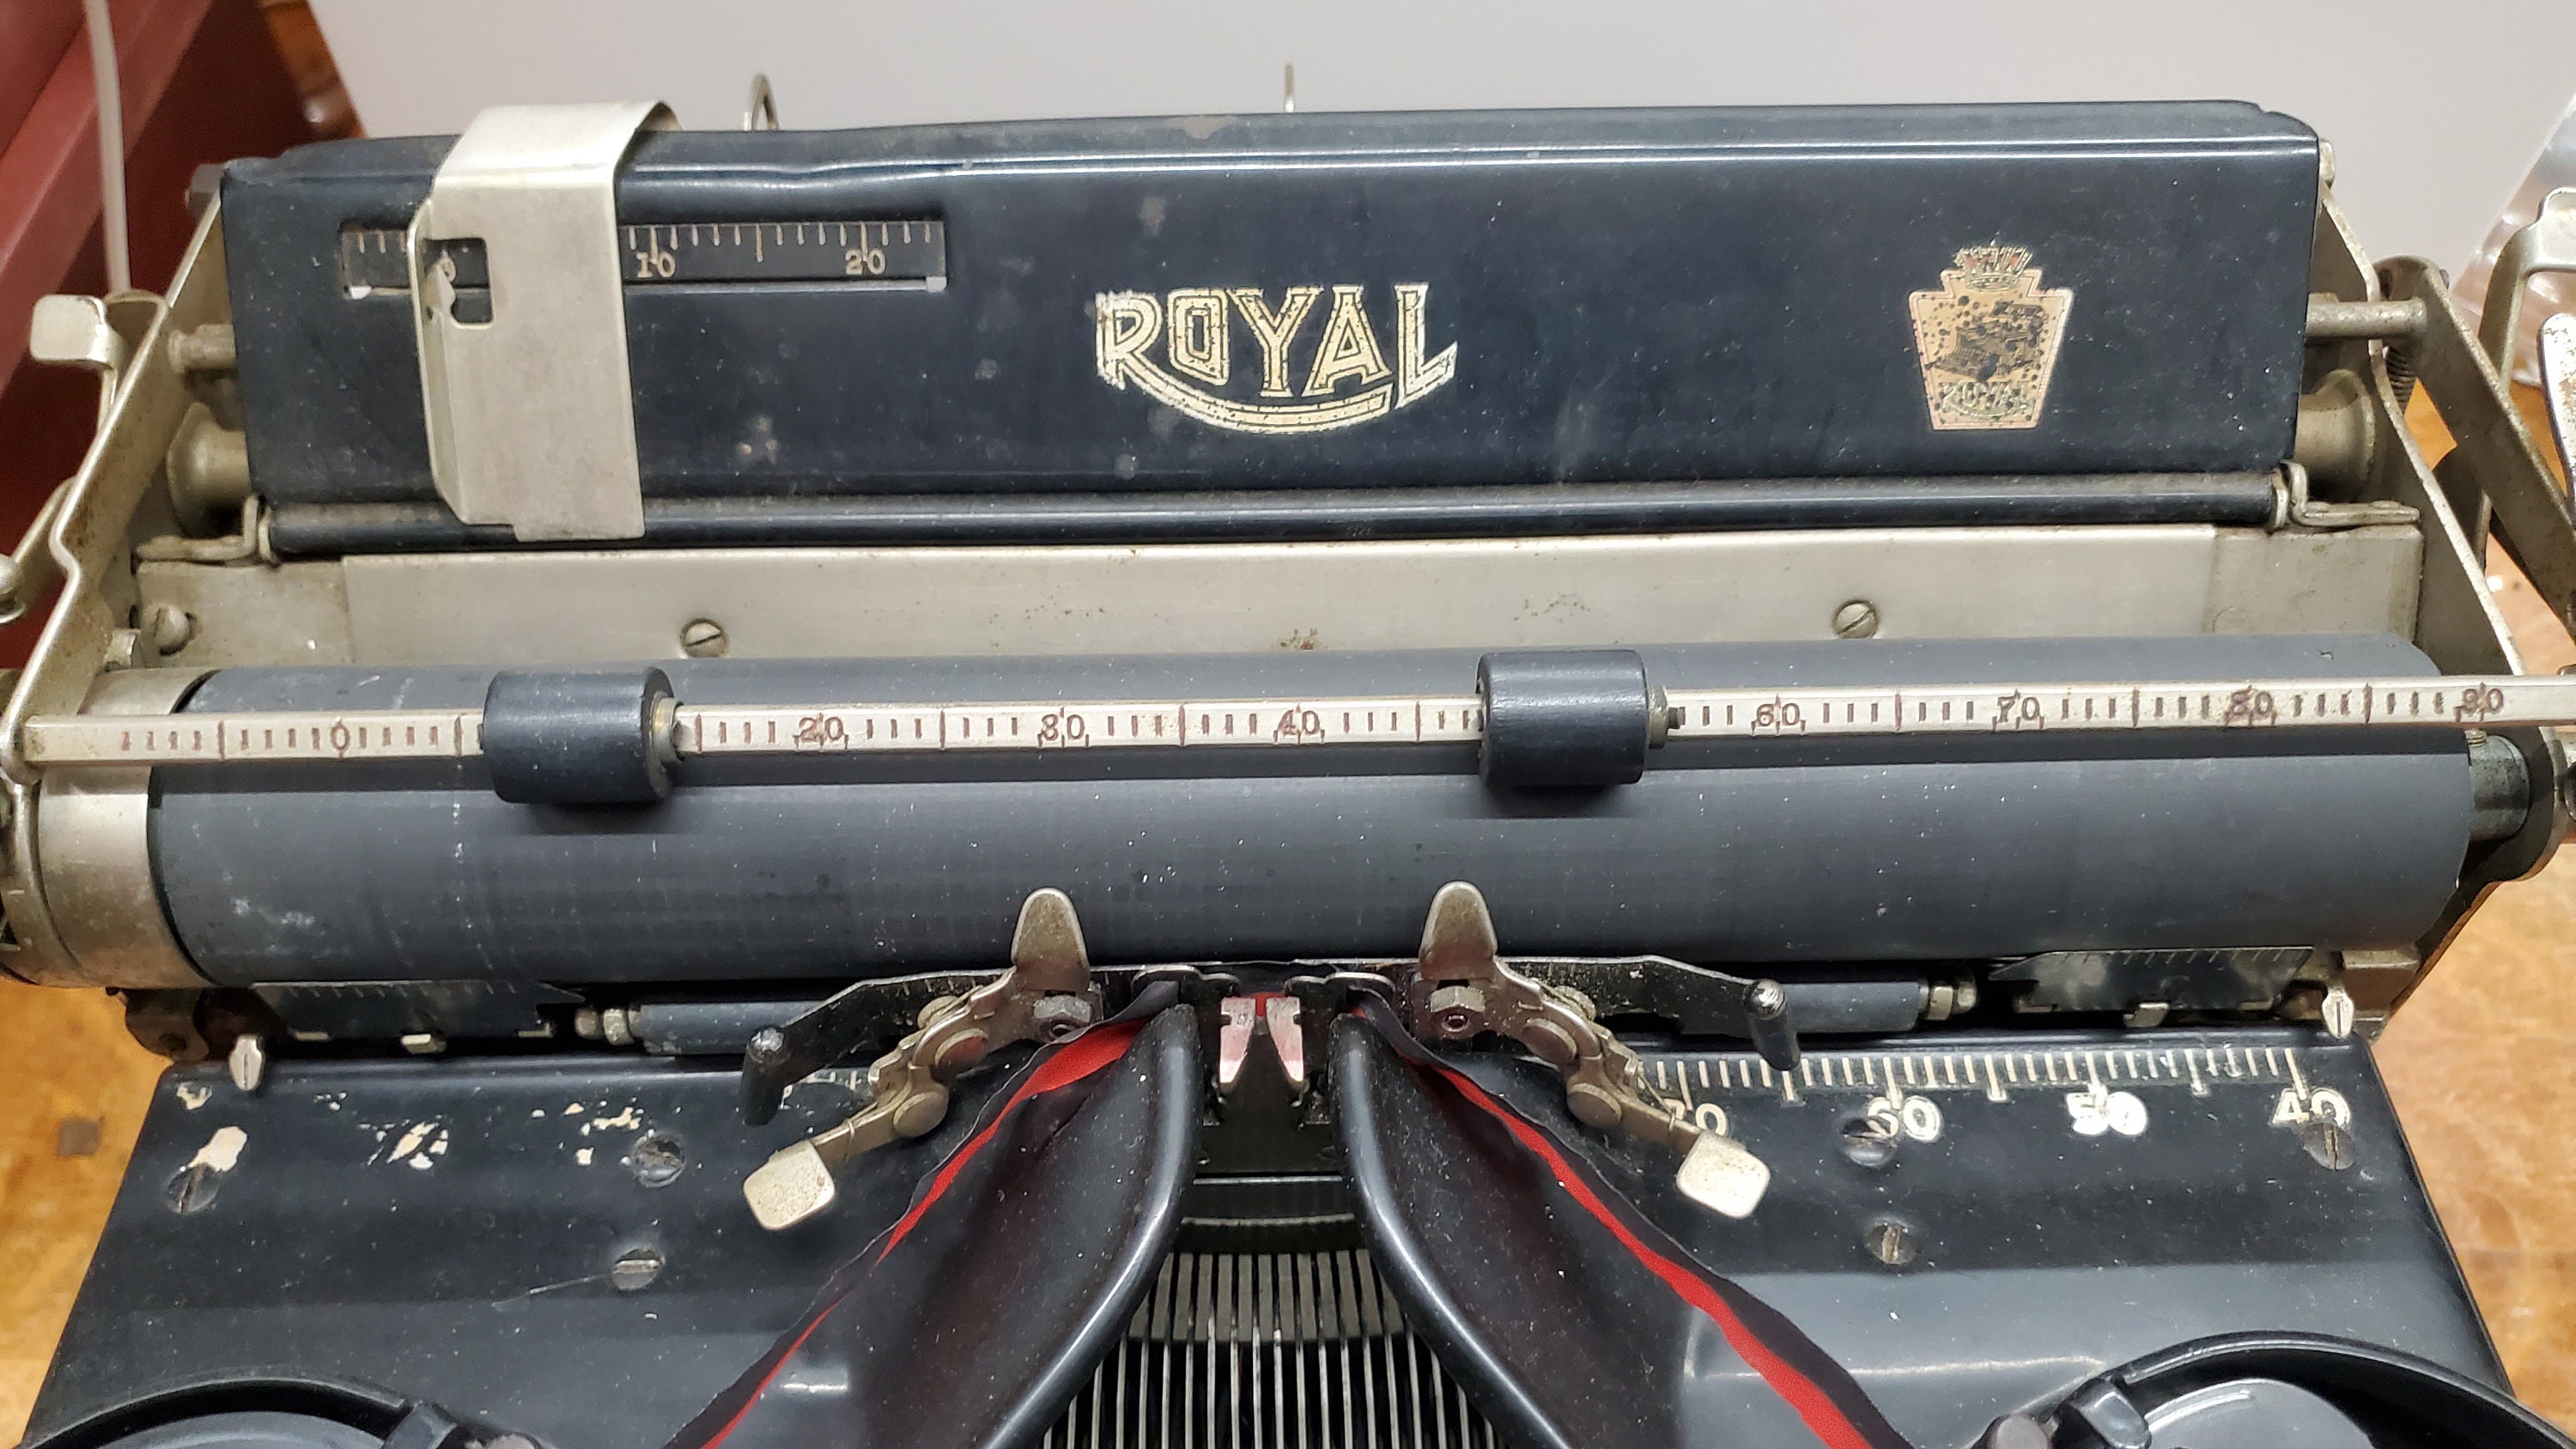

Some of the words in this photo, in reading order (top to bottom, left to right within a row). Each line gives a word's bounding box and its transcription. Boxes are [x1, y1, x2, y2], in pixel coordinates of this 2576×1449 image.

[636, 252, 676, 277] 10
[845, 249, 885, 275] 20
[1096, 282, 1458, 433] ROYAL
[799, 717, 843, 743] 20
[1041, 714, 1084, 741] 30
[1278, 710, 1320, 736] 40
[1756, 703, 1800, 726] 60
[1997, 696, 2040, 723] 70
[2461, 688, 2504, 714] 90
[1867, 1095, 1944, 1143] 60
[2066, 1091, 2148, 1135] 50
[2272, 1087, 2351, 1127] 40
